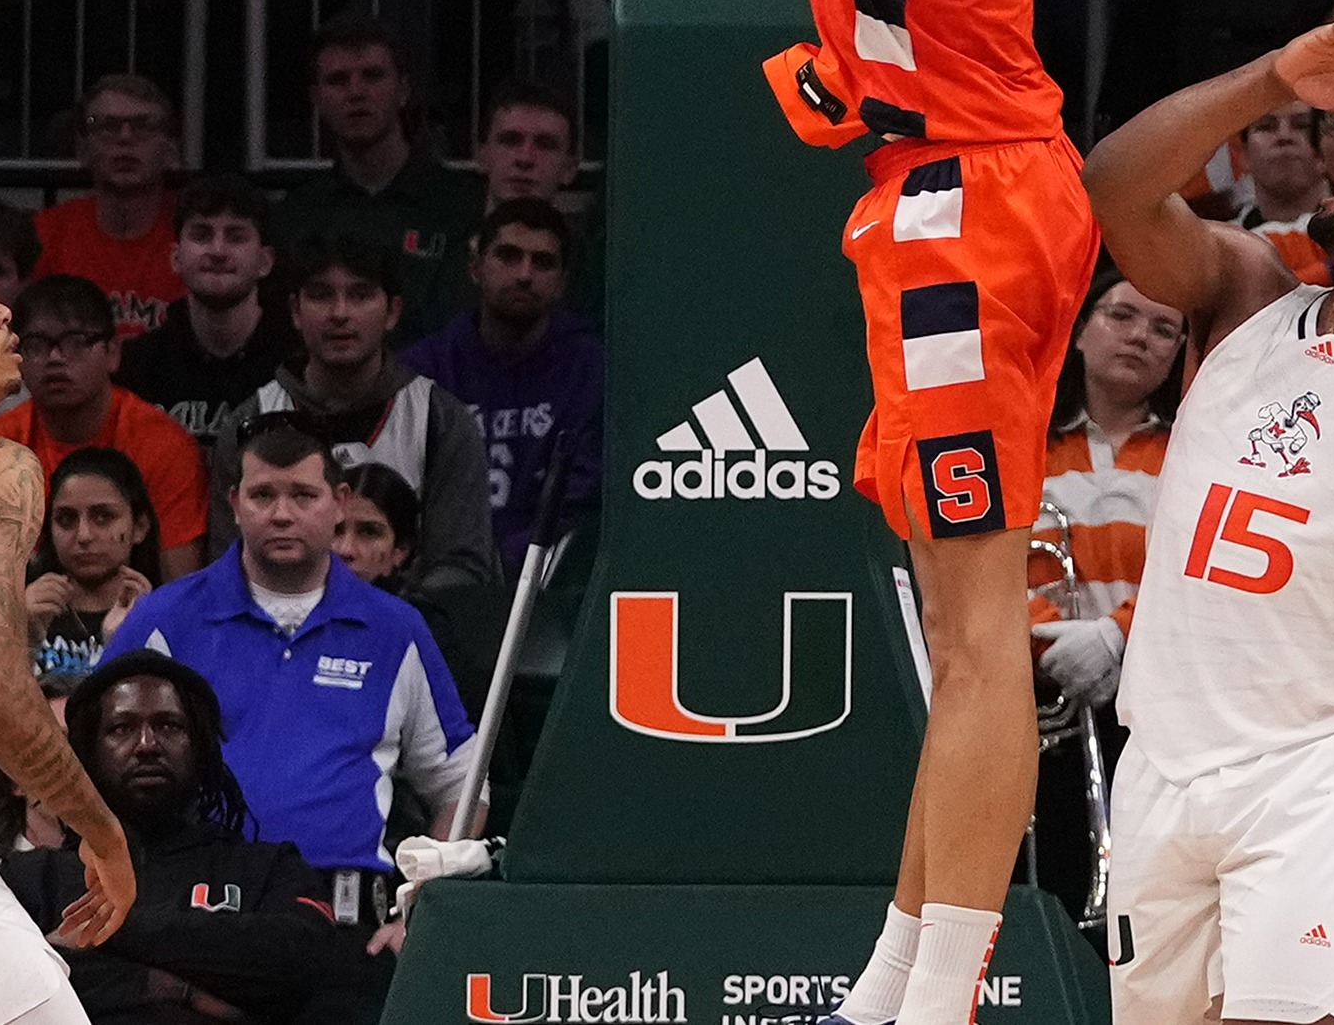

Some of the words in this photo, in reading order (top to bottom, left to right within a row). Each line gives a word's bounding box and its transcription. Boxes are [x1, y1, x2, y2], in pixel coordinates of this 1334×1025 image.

[633, 448, 841, 500] adidas
[931, 447, 992, 523] S
[1184, 482, 1311, 595] 15
[318, 655, 373, 675] BEST
[610, 591, 853, 743] U
[1299, 935, 1332, 949] adidas
[467, 970, 688, 1025] UHealth
[723, 974, 851, 1005] SPORTS
